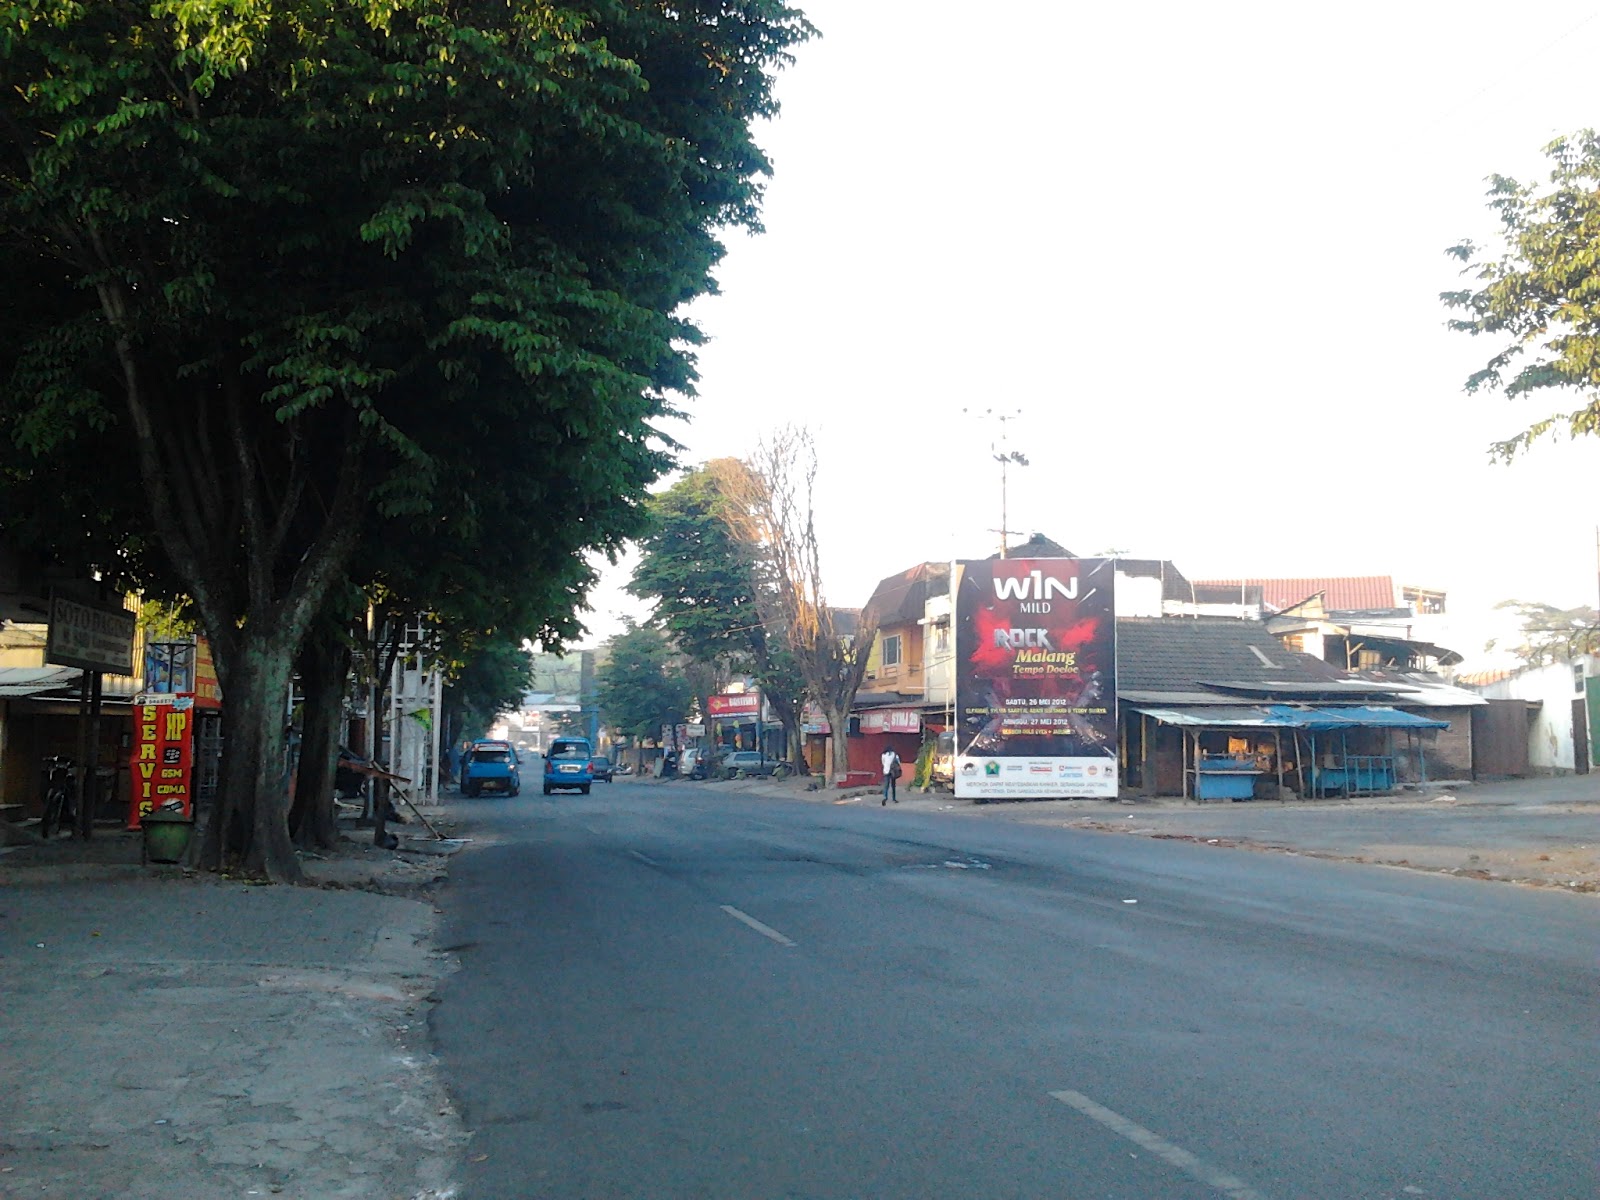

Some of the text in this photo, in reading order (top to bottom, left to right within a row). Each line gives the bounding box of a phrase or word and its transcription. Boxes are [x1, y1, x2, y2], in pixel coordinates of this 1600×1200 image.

[1020, 602, 1051, 614] MILD
[994, 628, 1055, 652] ROCK
[1015, 649, 1076, 665] Malang
[1012, 665, 1044, 674] Tempo
[165, 712, 186, 740] HP
[161, 768, 183, 778] GSM
[157, 785, 186, 794] CDMA
